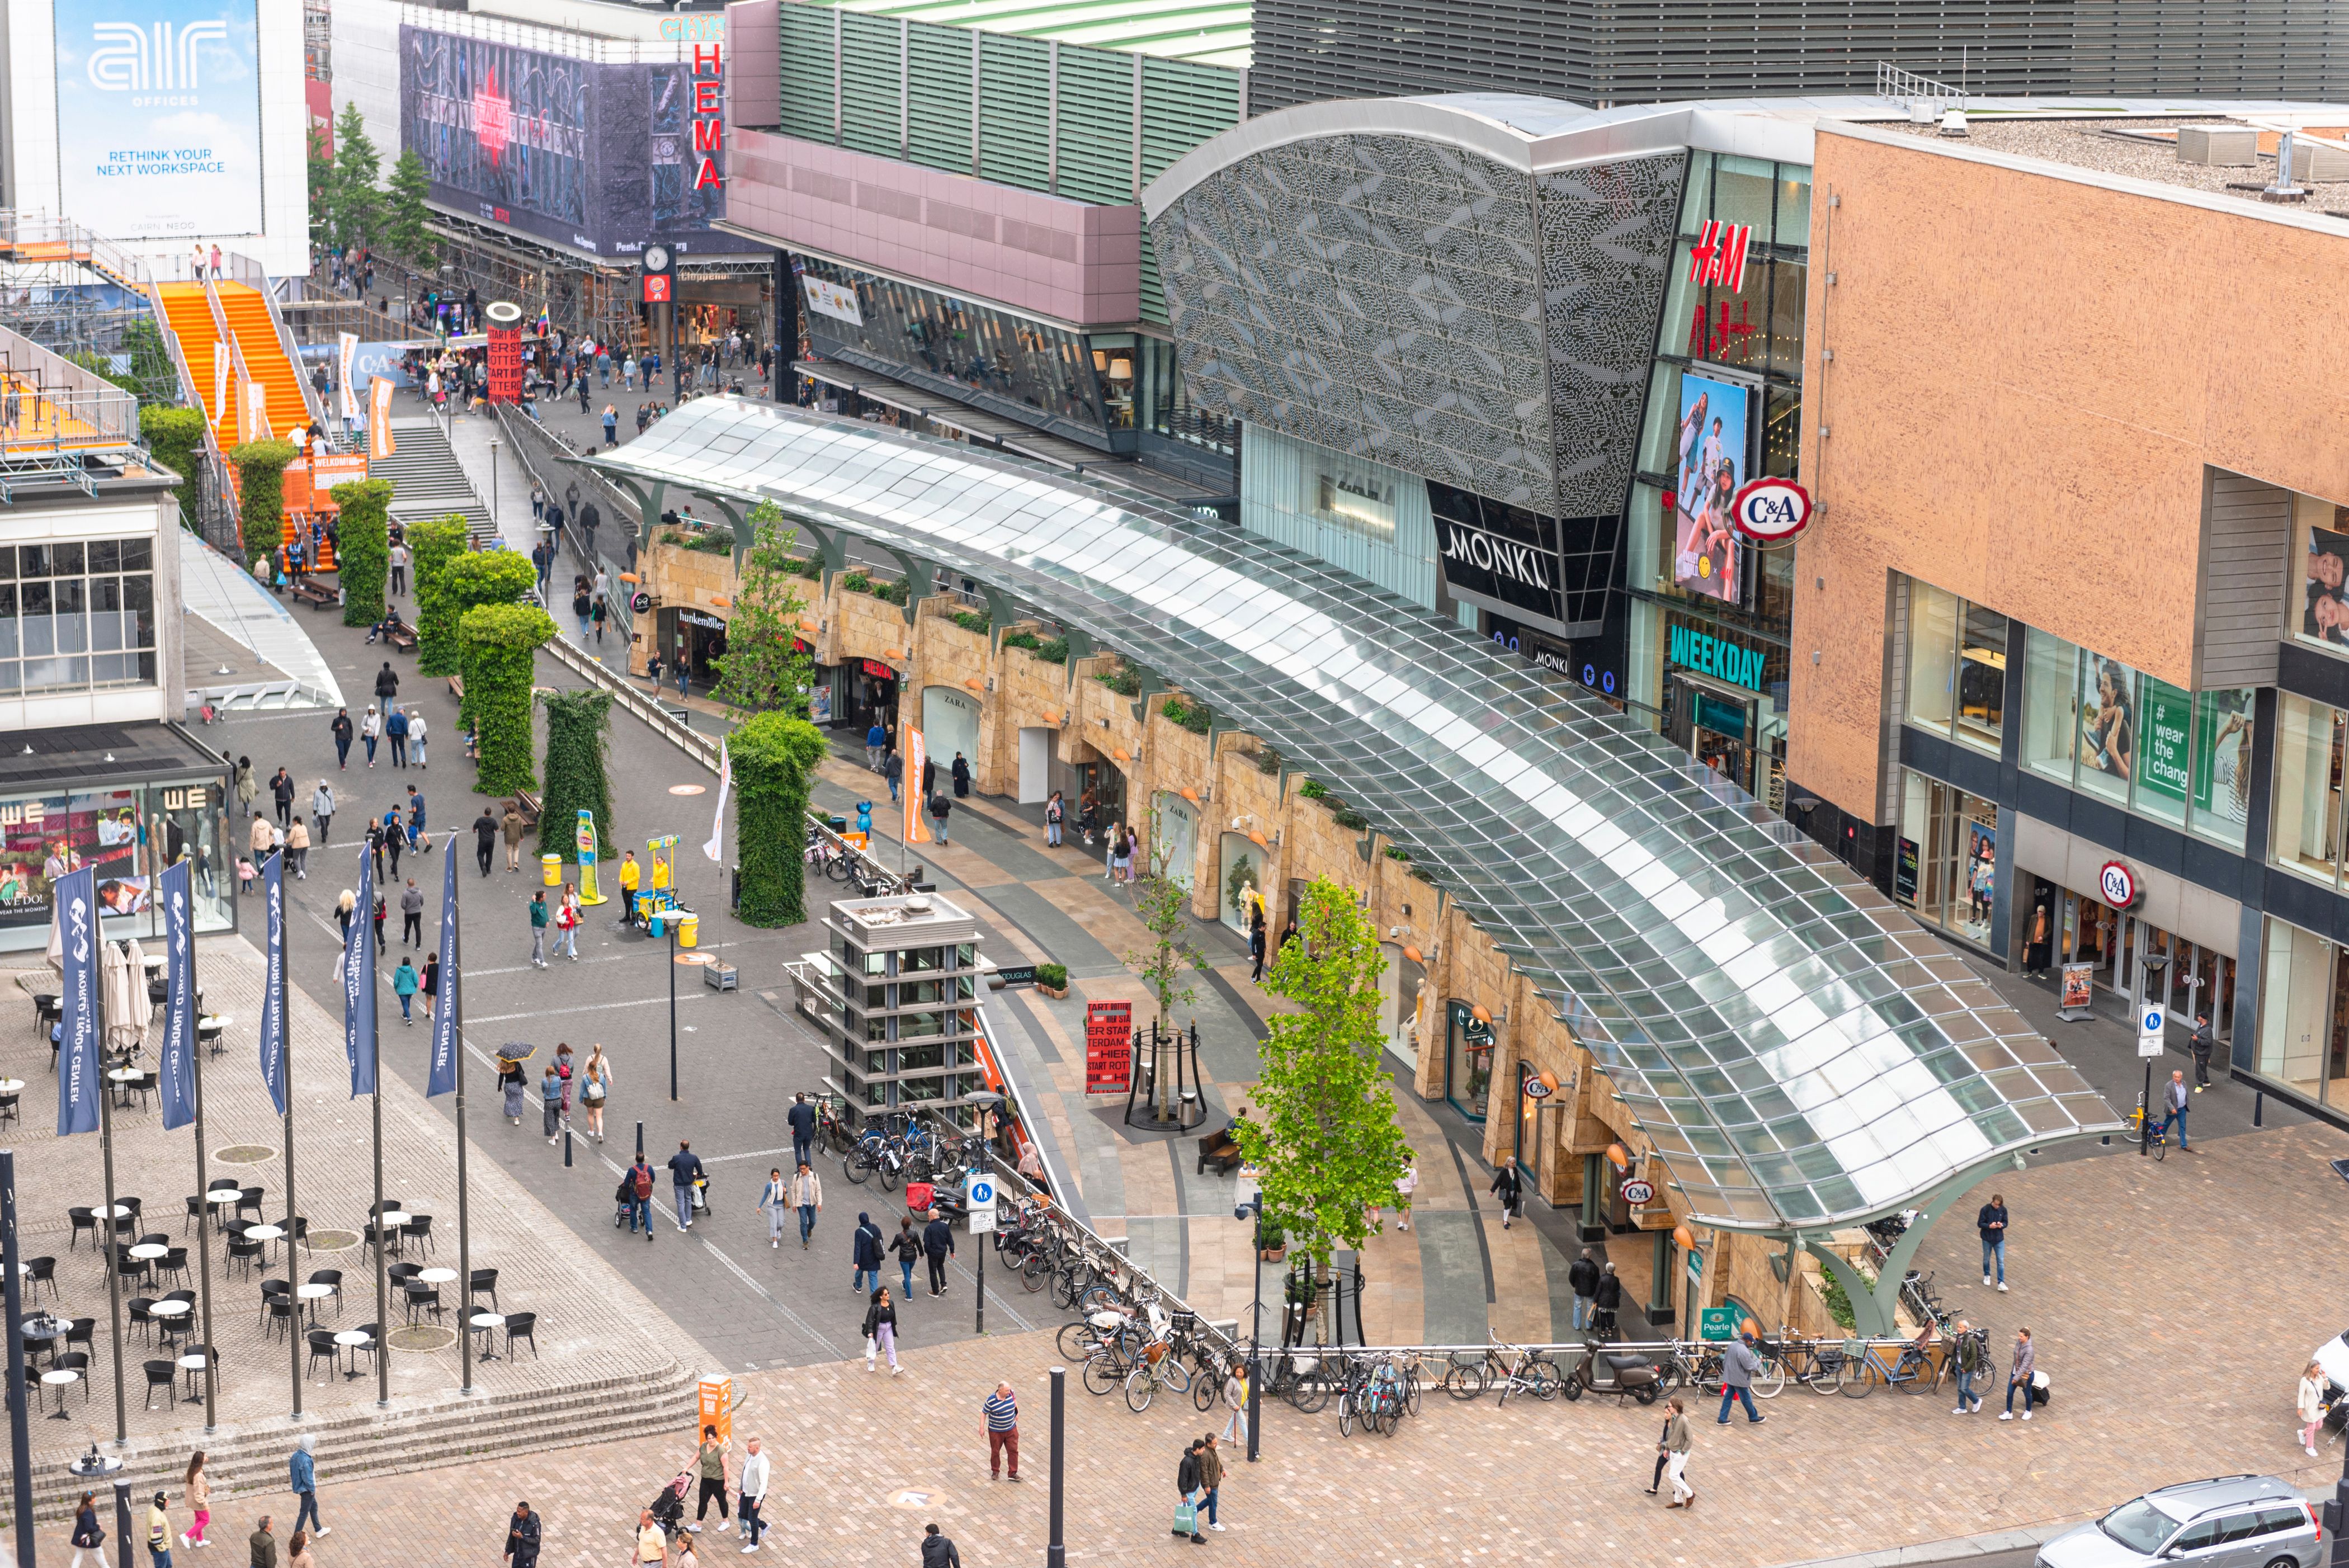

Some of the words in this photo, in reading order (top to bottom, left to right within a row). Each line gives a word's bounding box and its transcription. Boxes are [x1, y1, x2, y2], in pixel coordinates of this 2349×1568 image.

[87, 20, 227, 91] air
[132, 95, 199, 107] OFFICES
[692, 44, 721, 190] HEMA
[109, 150, 170, 162] RETHINK
[174, 149, 212, 160] YOUR
[97, 165, 133, 176] NEXT
[137, 162, 225, 175] WORKSPACE
[1690, 219, 1752, 294] H&M
[359, 353, 391, 374] C&A
[314, 457, 348, 467] WELKOM!
[1337, 470, 1395, 506] ZARA
[1748, 496, 1798, 524] C&A
[1446, 525, 1549, 591] MONKI
[1682, 549, 1699, 563] SMILEY
[1682, 561, 1699, 577] WORLD
[680, 608, 725, 631] hunkemöller
[1535, 651, 1567, 673] MONKI
[1671, 624, 1765, 692] WEEKDAY
[863, 659, 892, 681] HEMA
[944, 695, 966, 709] ZARA
[2156, 704, 2165, 721] #
[2156, 724, 2184, 744] wear
[2154, 739, 2173, 759] the
[912, 731, 921, 797] ROOFTOP
[164, 788, 206, 810] WE
[1, 802, 44, 825] WE
[1169, 804, 1188, 822] ZARA
[579, 836, 592, 844] Lipton
[2105, 872, 2126, 898] C&A
[3, 896, 20, 906] WE
[23, 894, 43, 905] DO!
[25, 905, 49, 914] MOMENT
[1002, 971, 1031, 980] DOUGLAS
[1088, 1038, 1124, 1047] TERDAM
[1101, 1050, 1130, 1058] HIER
[1087, 1062, 1106, 1070] START
[1529, 1083, 1549, 1093] C&A
[1628, 1187, 1649, 1198] C&A
[1704, 1323, 1730, 1331] Pearle
